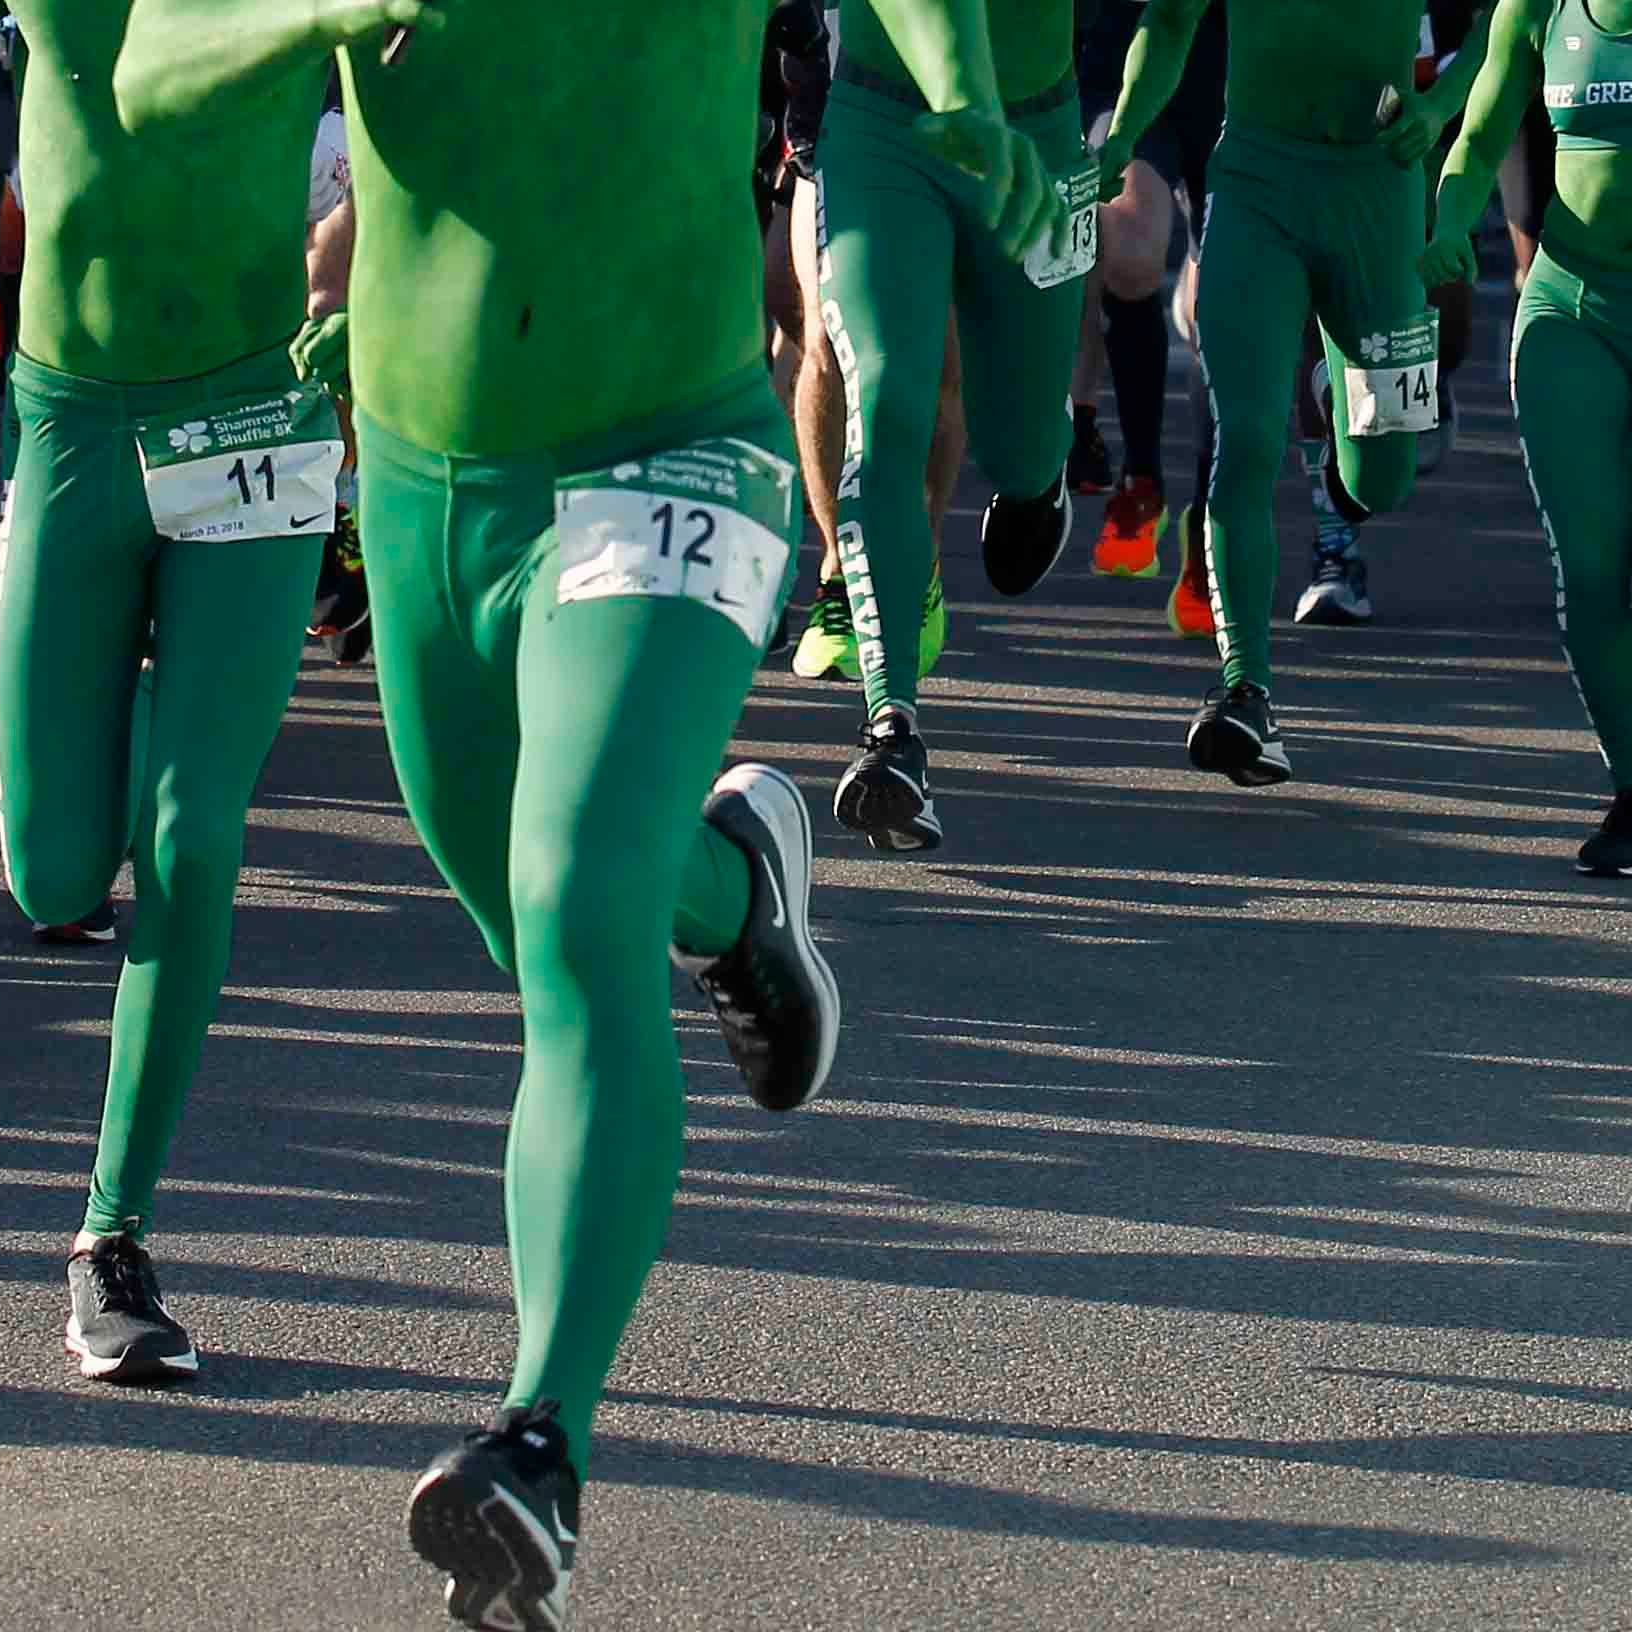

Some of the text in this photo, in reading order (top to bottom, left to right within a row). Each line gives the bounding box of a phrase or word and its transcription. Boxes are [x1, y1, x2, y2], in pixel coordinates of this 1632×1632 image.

[1071, 209, 1094, 253] 13
[1394, 367, 1431, 411] 14
[213, 409, 289, 435] Shamrock
[217, 421, 297, 448] Shuffle 8K
[227, 454, 275, 505] 11
[648, 469, 712, 493] Shuffle
[651, 502, 716, 567] 12
